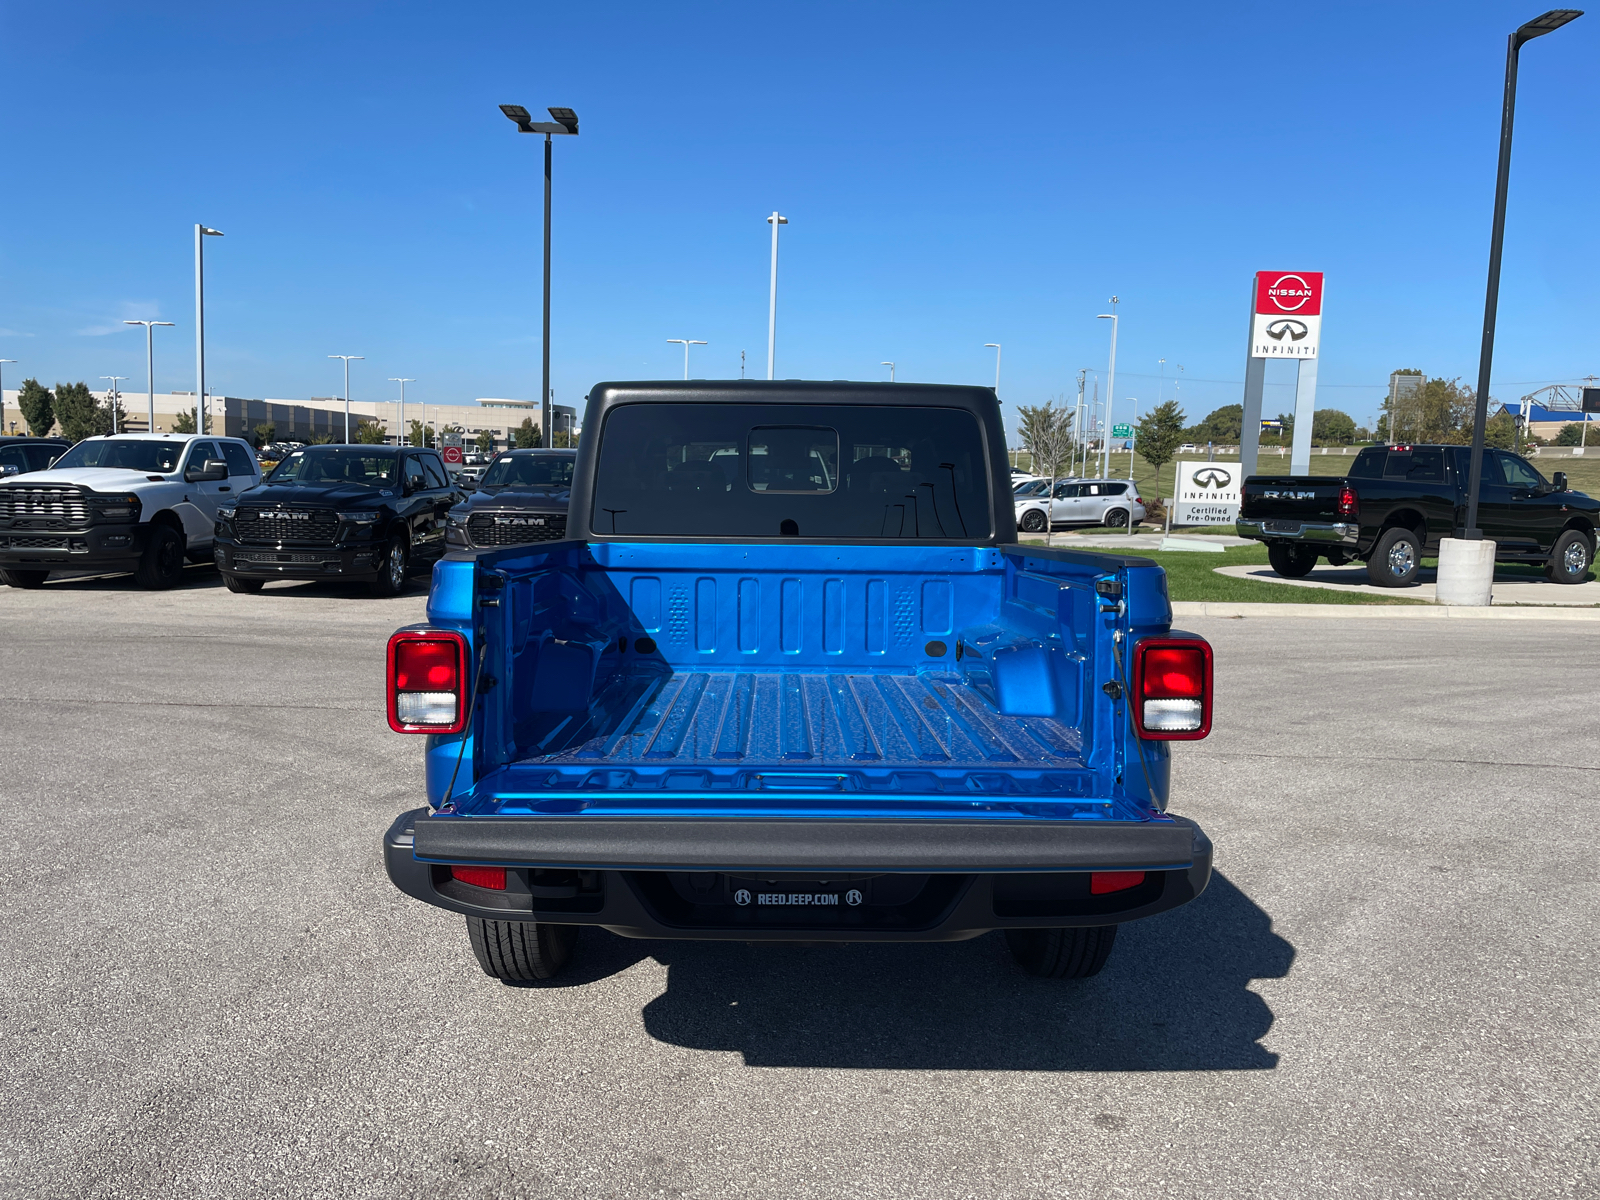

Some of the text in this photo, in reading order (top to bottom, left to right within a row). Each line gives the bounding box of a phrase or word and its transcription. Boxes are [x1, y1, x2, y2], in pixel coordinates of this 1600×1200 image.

[1268, 289, 1312, 297] NISSAN
[1256, 345, 1316, 355] INFINITI
[13, 493, 61, 502] RAM
[1184, 492, 1236, 500] INFINITI
[1263, 490, 1316, 500] RAM
[259, 511, 309, 520] RAM
[1191, 507, 1228, 515] Certified
[494, 517, 545, 526] RAM
[757, 894, 839, 905] REEDJEEP.COM
